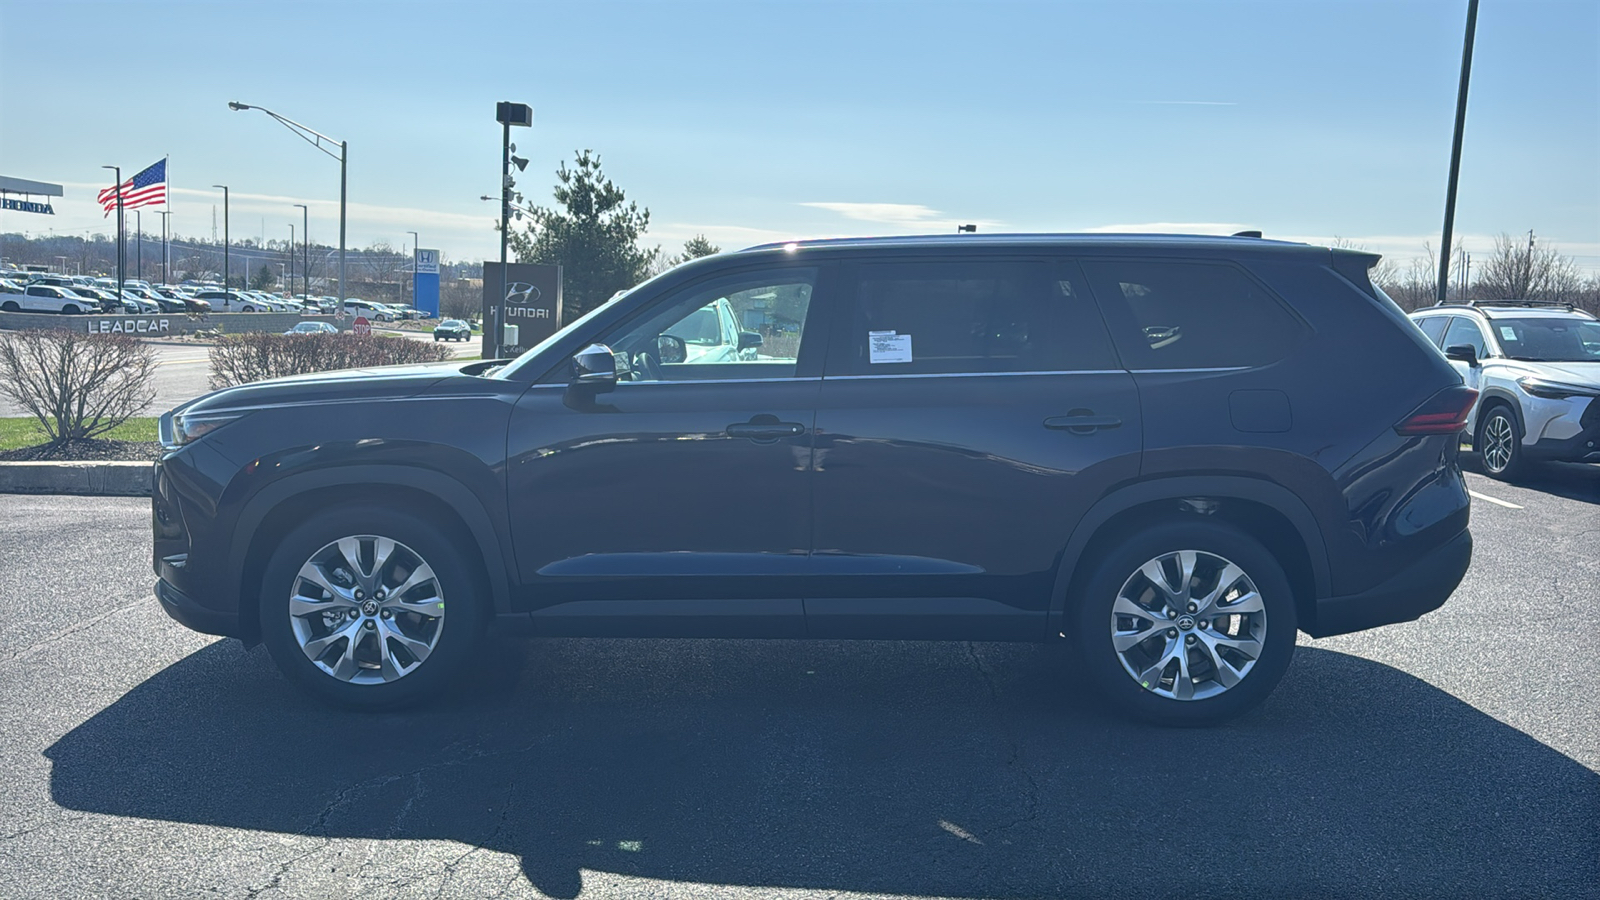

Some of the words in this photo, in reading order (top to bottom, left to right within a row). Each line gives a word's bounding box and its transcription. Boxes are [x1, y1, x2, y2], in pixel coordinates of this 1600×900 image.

[2, 199, 55, 215] HONDA
[88, 319, 169, 334] LEADCAR
[354, 324, 370, 334] STOP
